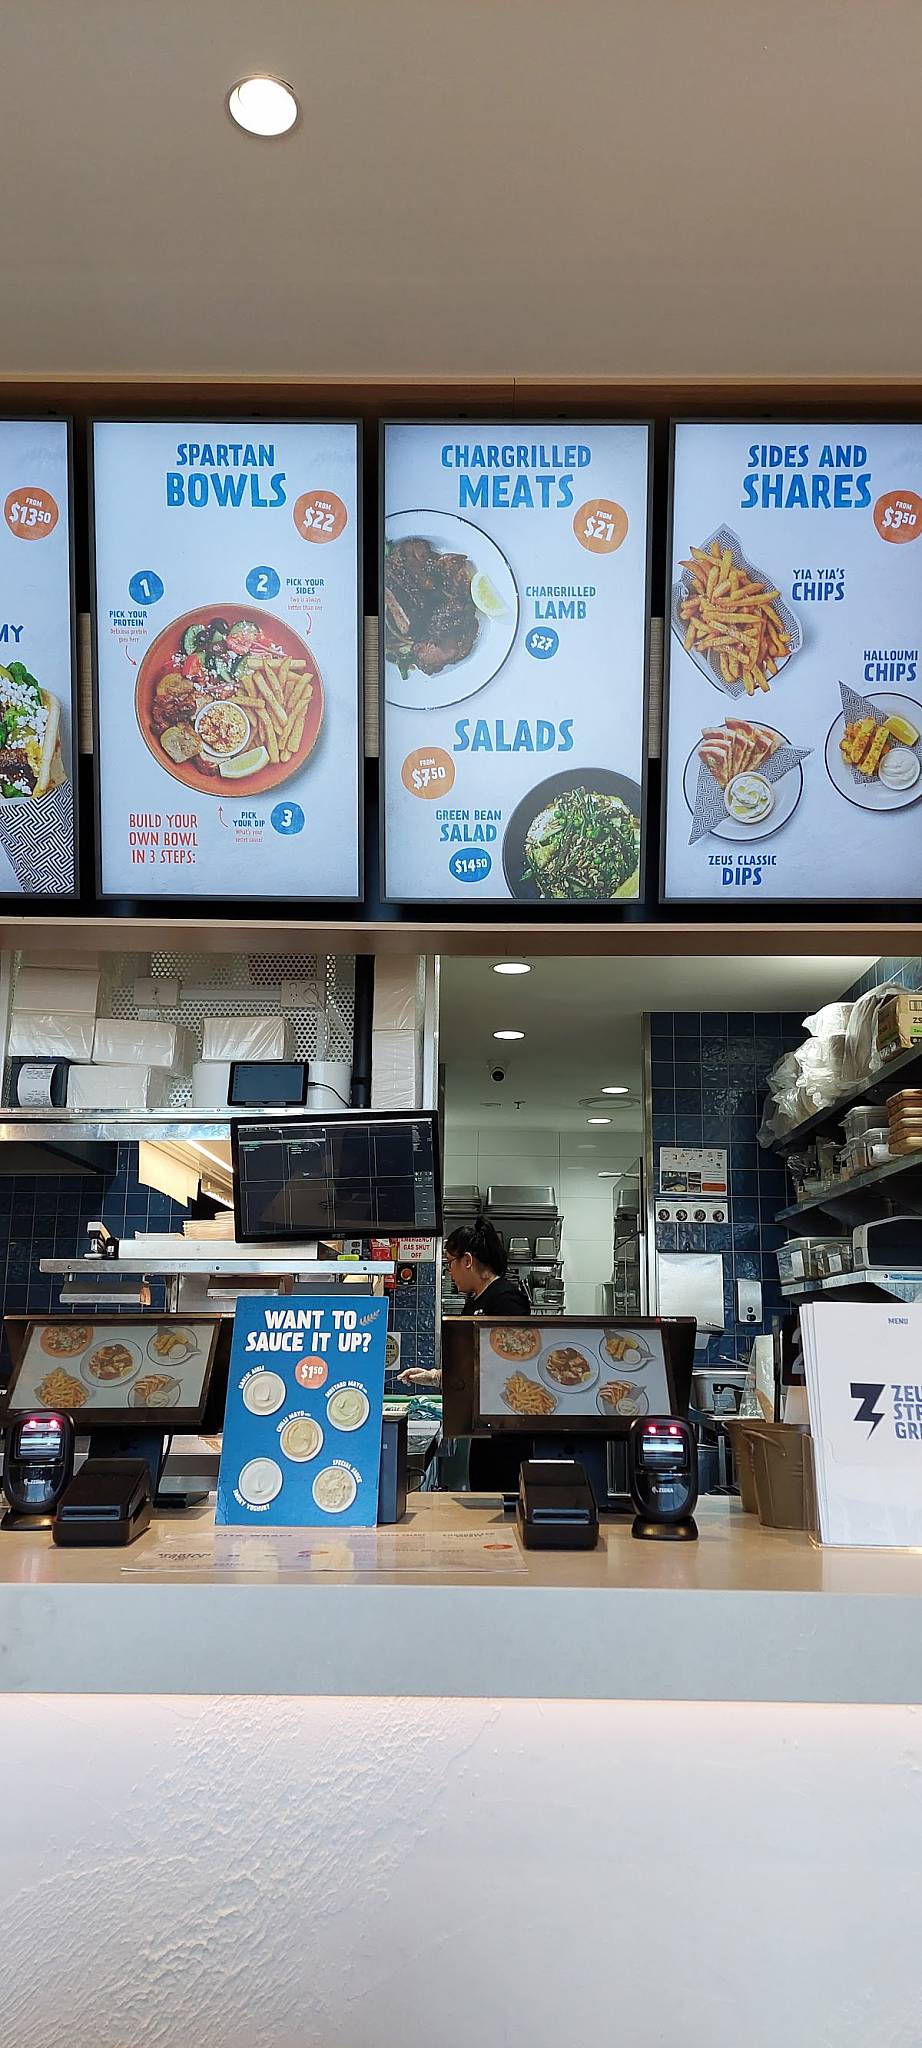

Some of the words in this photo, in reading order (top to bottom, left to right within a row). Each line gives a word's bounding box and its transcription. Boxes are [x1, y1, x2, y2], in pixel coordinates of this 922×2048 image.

[177, 443, 275, 467] SPARTAN
[441, 445, 592, 468] CHARGRILLED
[748, 445, 809, 468] SIDES
[819, 445, 867, 467] AND
[166, 472, 287, 508] BOWLS
[459, 474, 574, 508] MEATS
[741, 474, 872, 509] SHARES
[26, 497, 43, 508] FROM
[315, 500, 332, 511] FROM
[896, 501, 912, 511] FROM
[303, 507, 335, 533] $22
[596, 511, 613, 521] FROM
[584, 516, 616, 542] $21
[792, 569, 812, 580] YIA
[817, 568, 845, 580] YIA'S
[140, 578, 150, 597] 1
[257, 574, 269, 592] 2
[286, 578, 302, 586] PICK
[304, 578, 325, 586] YOUR
[295, 587, 316, 595] SIDES
[526, 586, 596, 597] CHARGRILLED
[791, 582, 845, 601] CHIPS
[109, 610, 125, 618] PICK
[128, 610, 148, 618] YOUR
[534, 601, 587, 620] LAMB
[113, 619, 144, 627] PROTEIN
[530, 633, 553, 651] $27
[864, 650, 918, 661] HALLOUMI
[864, 663, 917, 682] CHIPS
[453, 719, 575, 752] SALADS
[420, 758, 436, 767] FROM
[129, 814, 161, 828] BUILD
[166, 815, 197, 828] YOUR
[241, 811, 257, 819] PICK
[281, 809, 293, 827] 3
[436, 810, 469, 820] GREEN
[474, 810, 501, 820] BEAN
[129, 832, 159, 846] OWN
[164, 832, 198, 846] BOWL
[439, 824, 498, 842] SALAD
[132, 850, 145, 863] IN
[150, 850, 155, 863] 3
[160, 850, 196, 863] STEPS:
[708, 856, 733, 865] ZEUS
[737, 856, 777, 866] CLASSIC
[722, 868, 762, 885] DIPS
[265, 1310, 324, 1330] WANT
[332, 1310, 357, 1330] TO
[245, 1332, 303, 1352] SAUCE
[311, 1333, 330, 1352] IT
[338, 1333, 372, 1352] UP?
[347, 1380, 364, 1389] MAYO
[288, 1410, 305, 1419] MAYO
